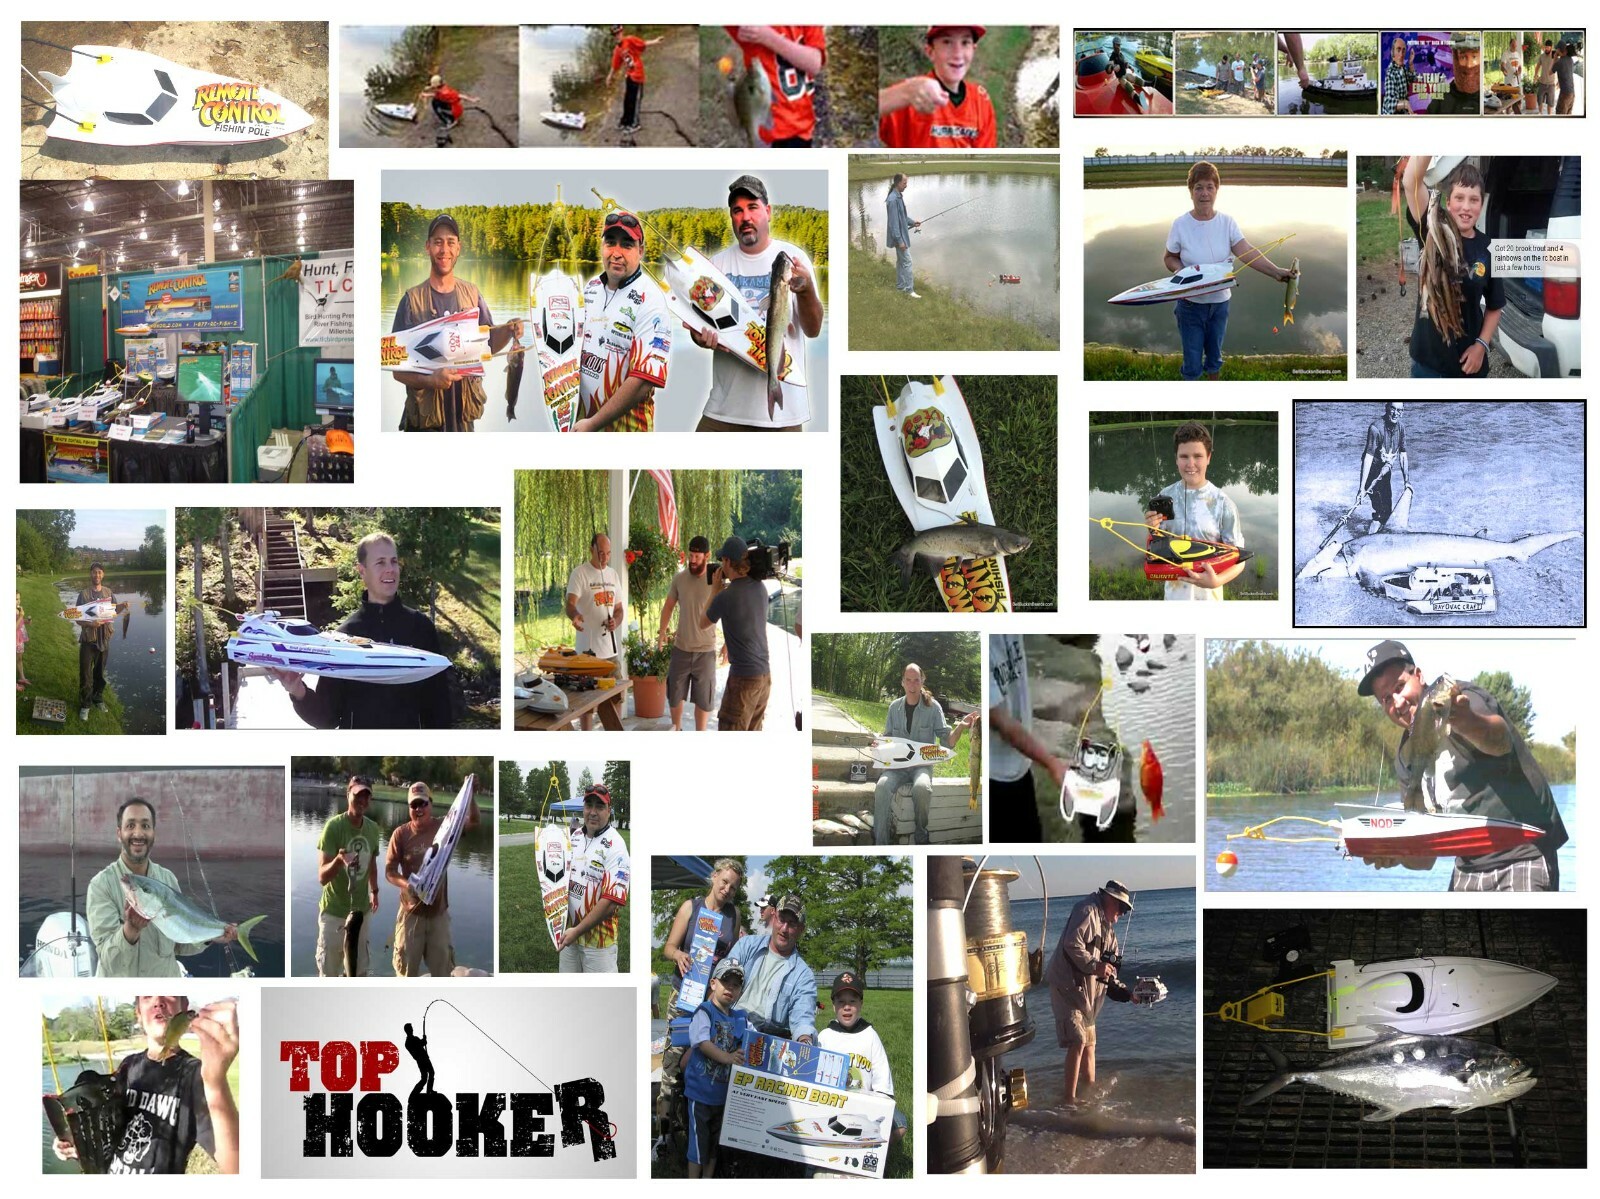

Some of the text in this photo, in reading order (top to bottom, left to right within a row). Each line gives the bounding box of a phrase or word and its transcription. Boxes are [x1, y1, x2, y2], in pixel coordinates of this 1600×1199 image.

[1423, 73, 1440, 83] TEAM
[192, 82, 260, 111] REMOTE
[199, 100, 286, 127] CONTROL
[248, 127, 271, 136] POLE
[304, 263, 329, 276] Hunt,
[173, 273, 208, 292] CONTROL
[318, 312, 341, 321] Hunting
[543, 358, 580, 389] REMOTE
[544, 372, 581, 405] CONTRO
[1370, 818, 1393, 828] NOD
[280, 1041, 400, 1091] TOP
[856, 1054, 872, 1072] YOU
[733, 1071, 848, 1108] EP RACING BOAT
[303, 1077, 617, 1162] HOOKER
